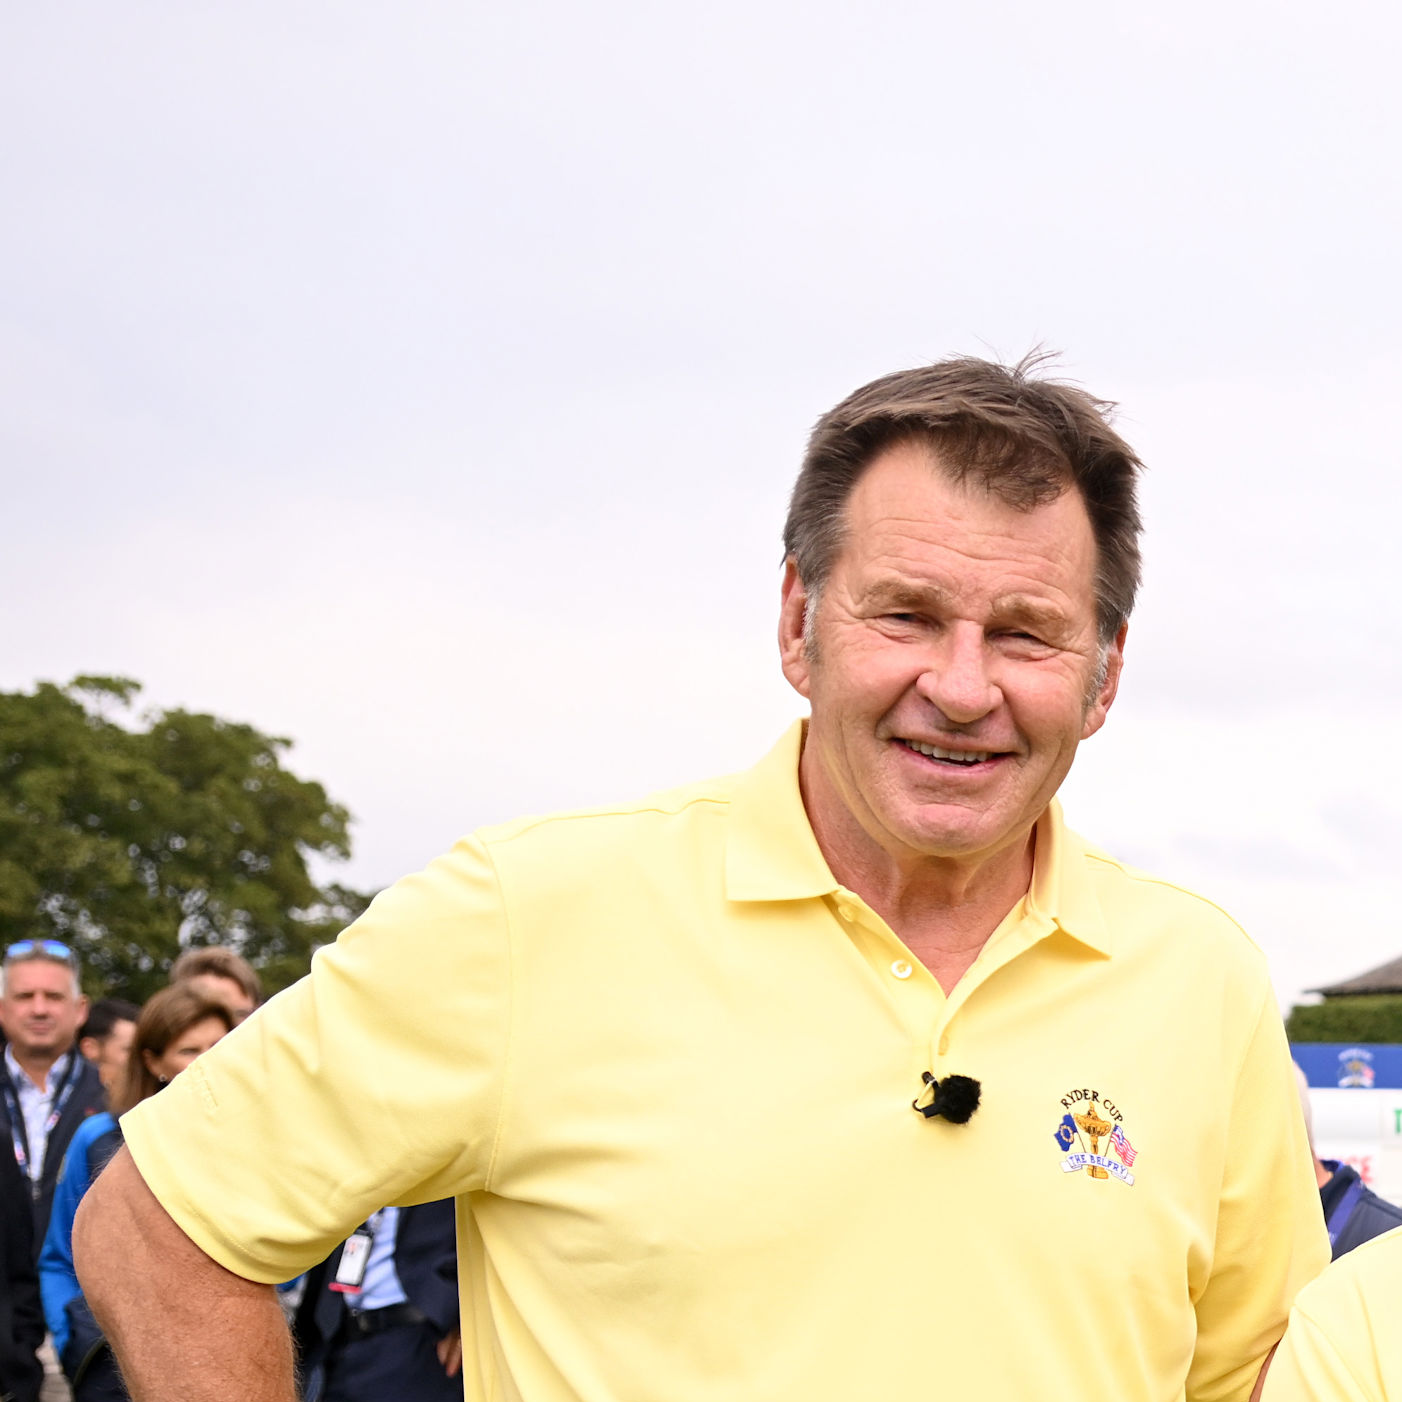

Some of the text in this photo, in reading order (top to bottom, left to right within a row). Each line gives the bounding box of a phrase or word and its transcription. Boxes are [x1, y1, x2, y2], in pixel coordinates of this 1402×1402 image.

[1060, 1088, 1123, 1122] RYDER CUP
[1068, 1154, 1126, 1174] THE BELFRY
